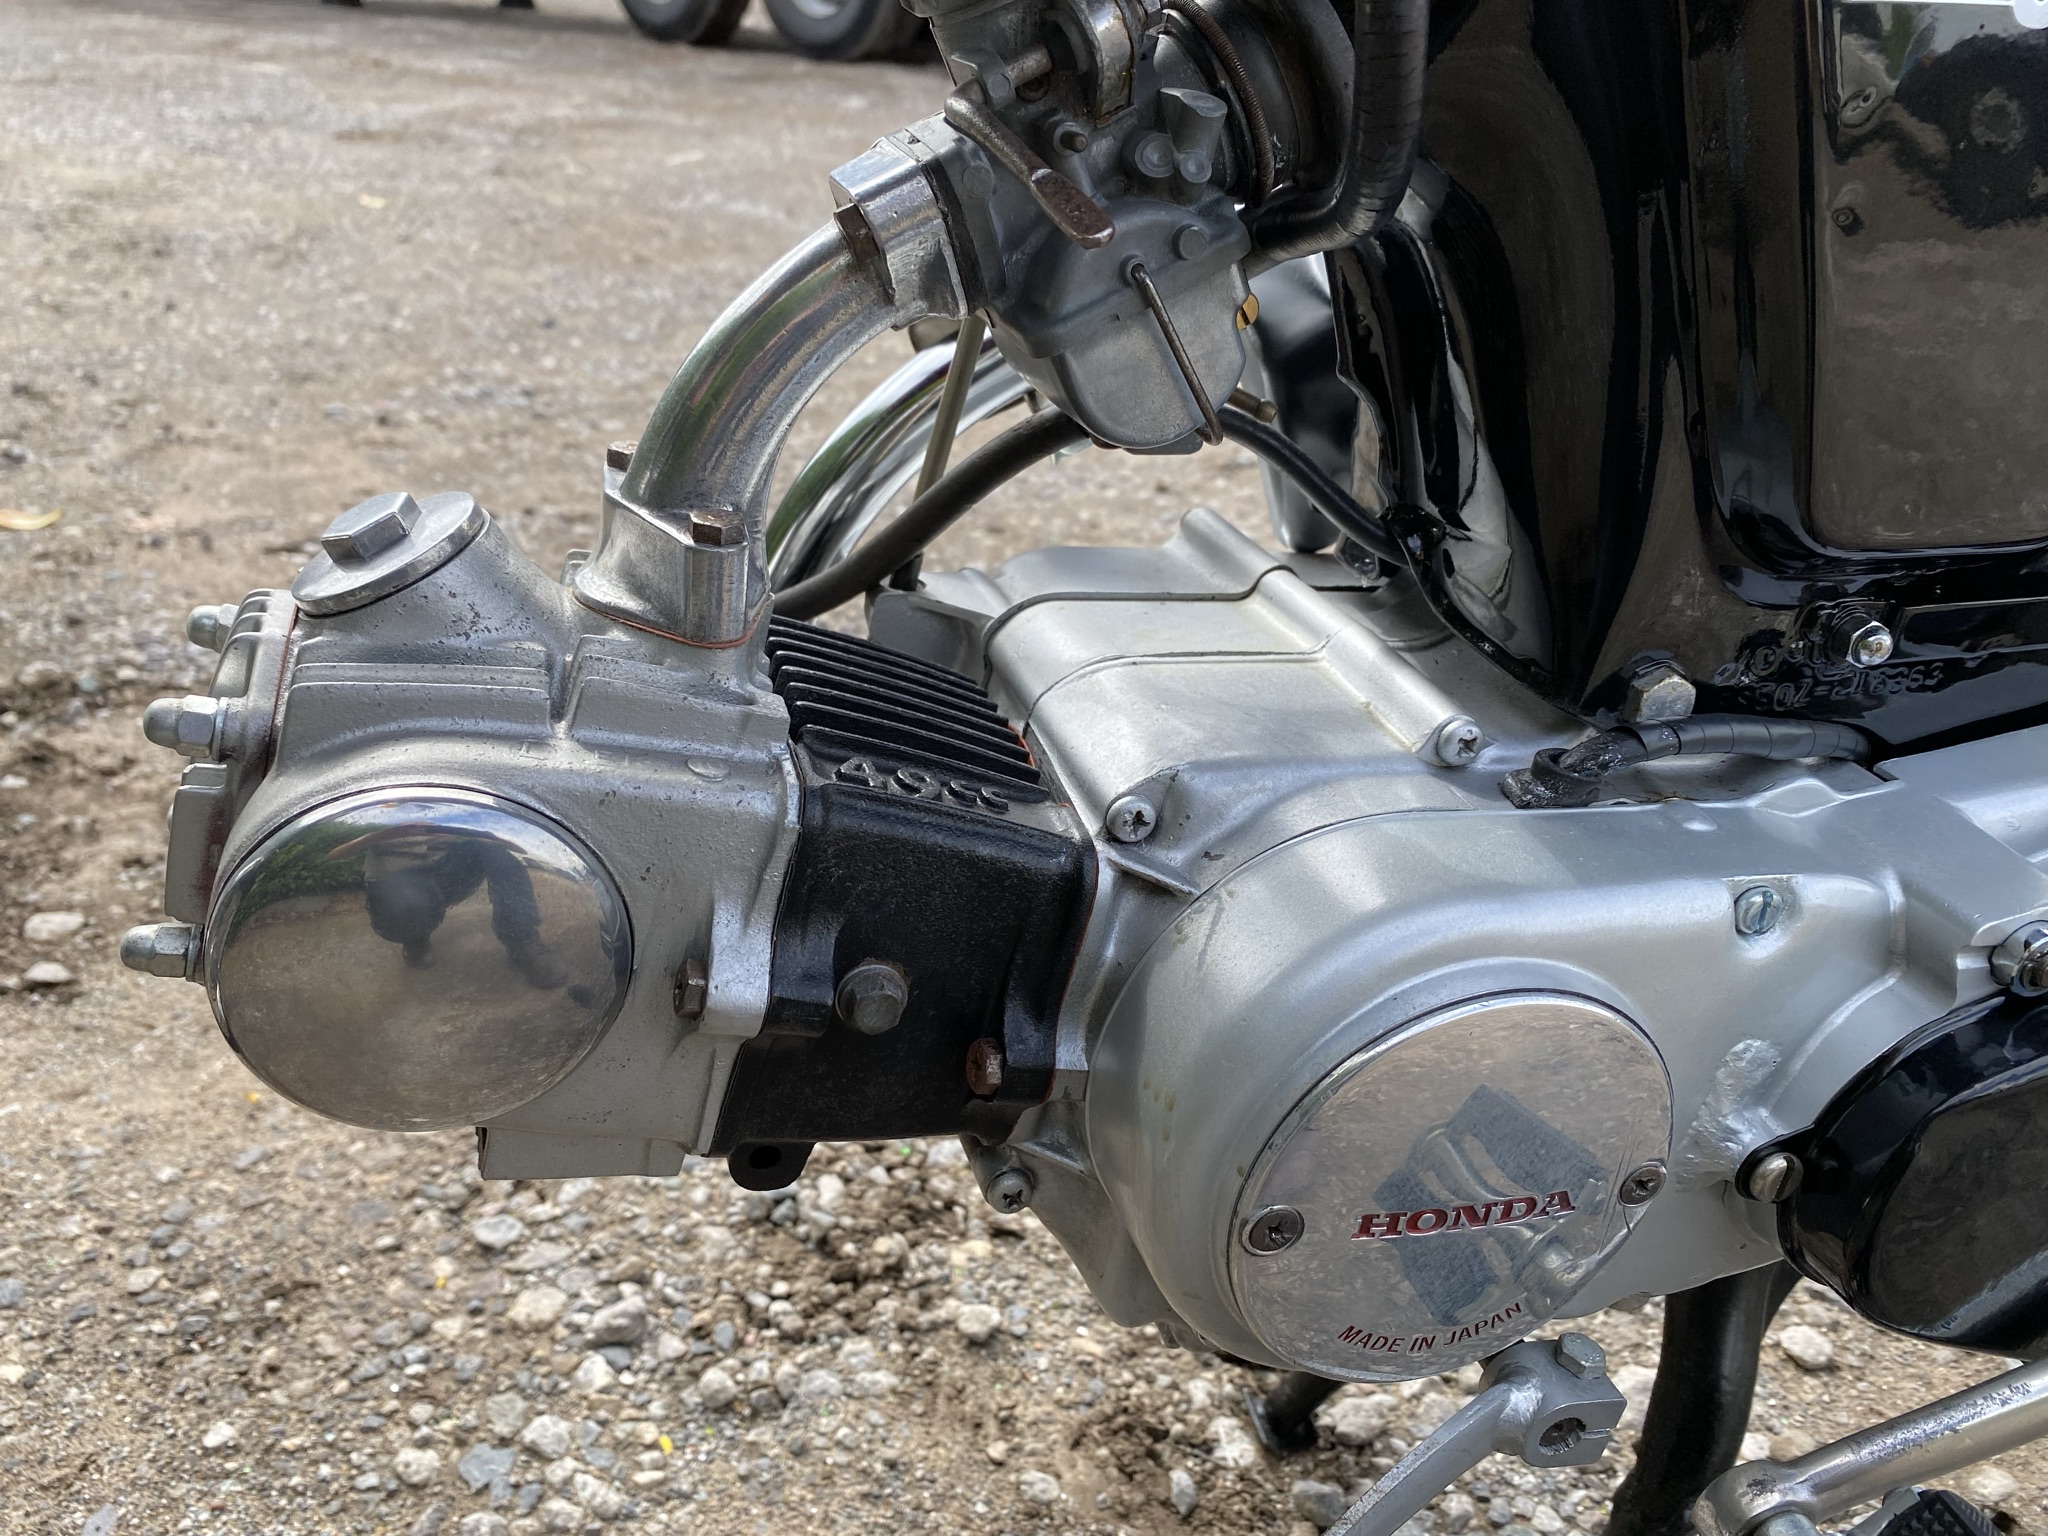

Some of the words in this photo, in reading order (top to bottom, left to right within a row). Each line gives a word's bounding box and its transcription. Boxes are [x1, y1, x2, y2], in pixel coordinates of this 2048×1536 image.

[1351, 1190, 1576, 1240] HONDA
[1338, 1325, 1405, 1353] MADE
[1409, 1334, 1437, 1354] IN
[1444, 1302, 1523, 1346] JAPAN
